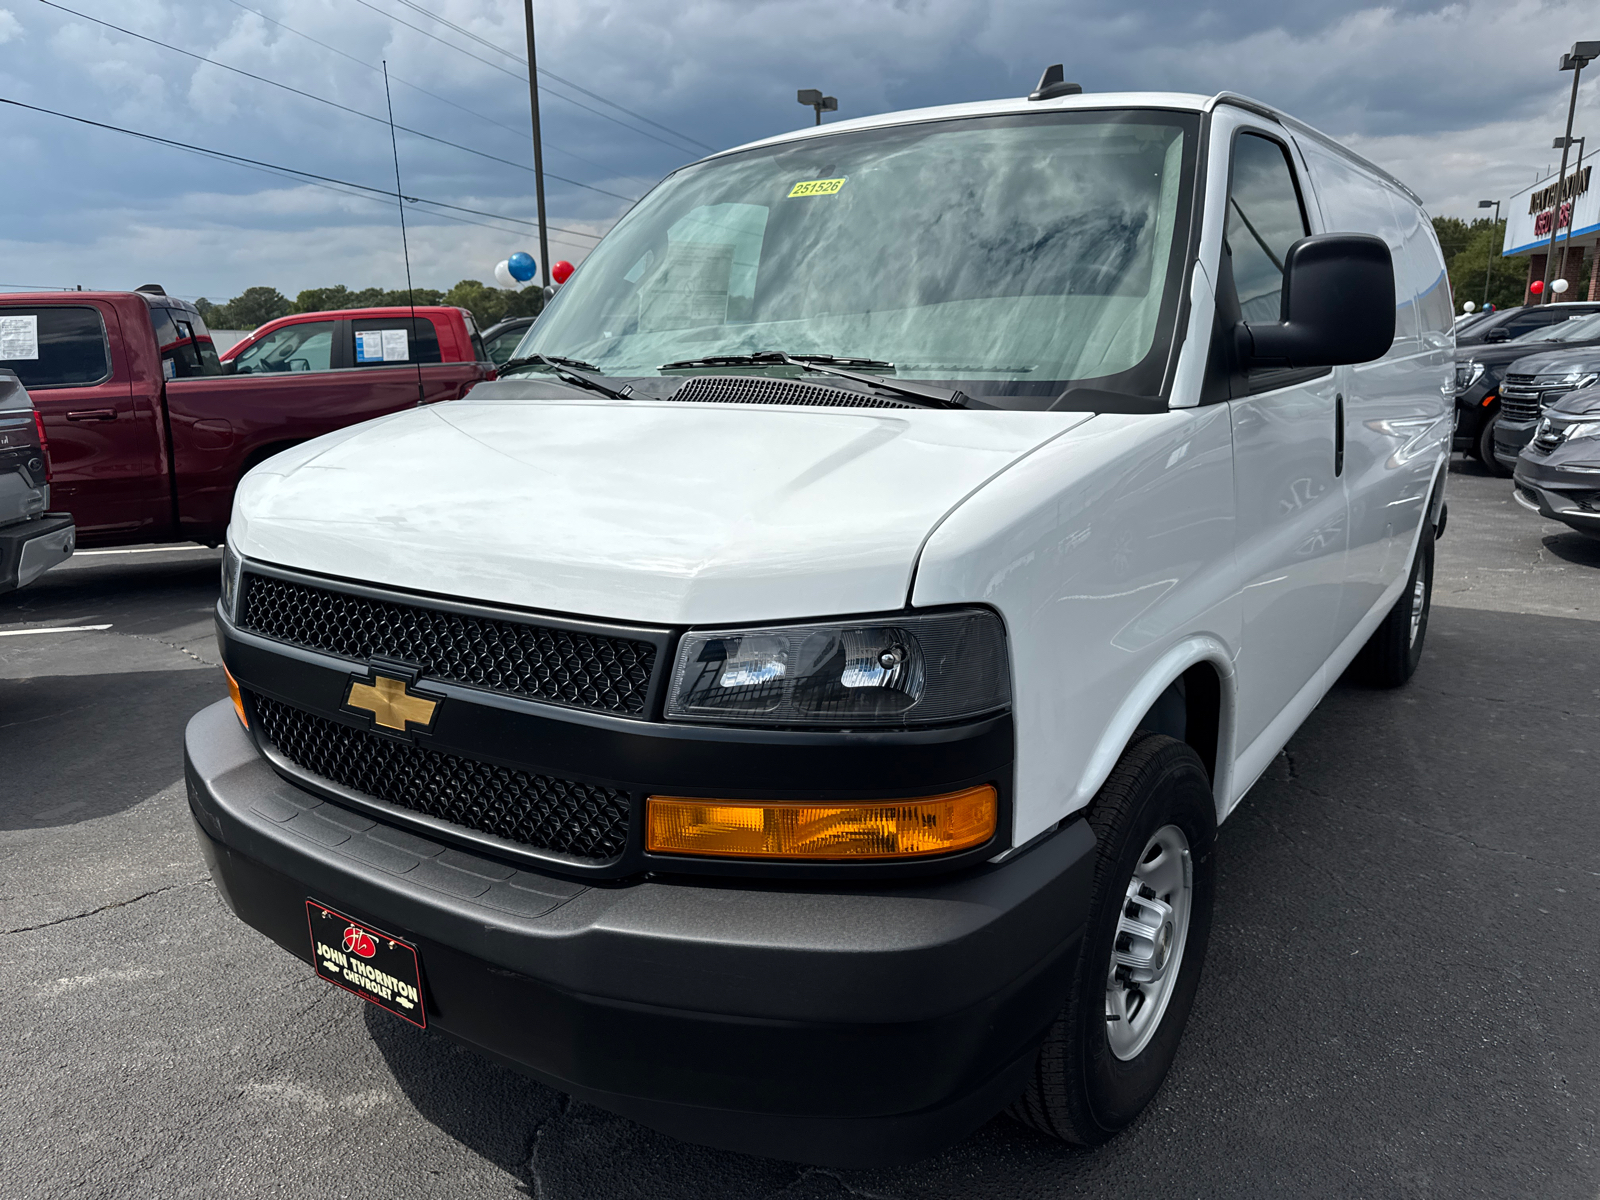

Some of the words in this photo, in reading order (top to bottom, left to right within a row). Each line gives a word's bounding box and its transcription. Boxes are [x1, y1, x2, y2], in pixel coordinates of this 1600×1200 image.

[793, 181, 841, 194] 251526
[317, 942, 348, 968] JOHN
[350, 957, 419, 1002] THORNTON
[343, 968, 392, 1001] CHEVROLET
